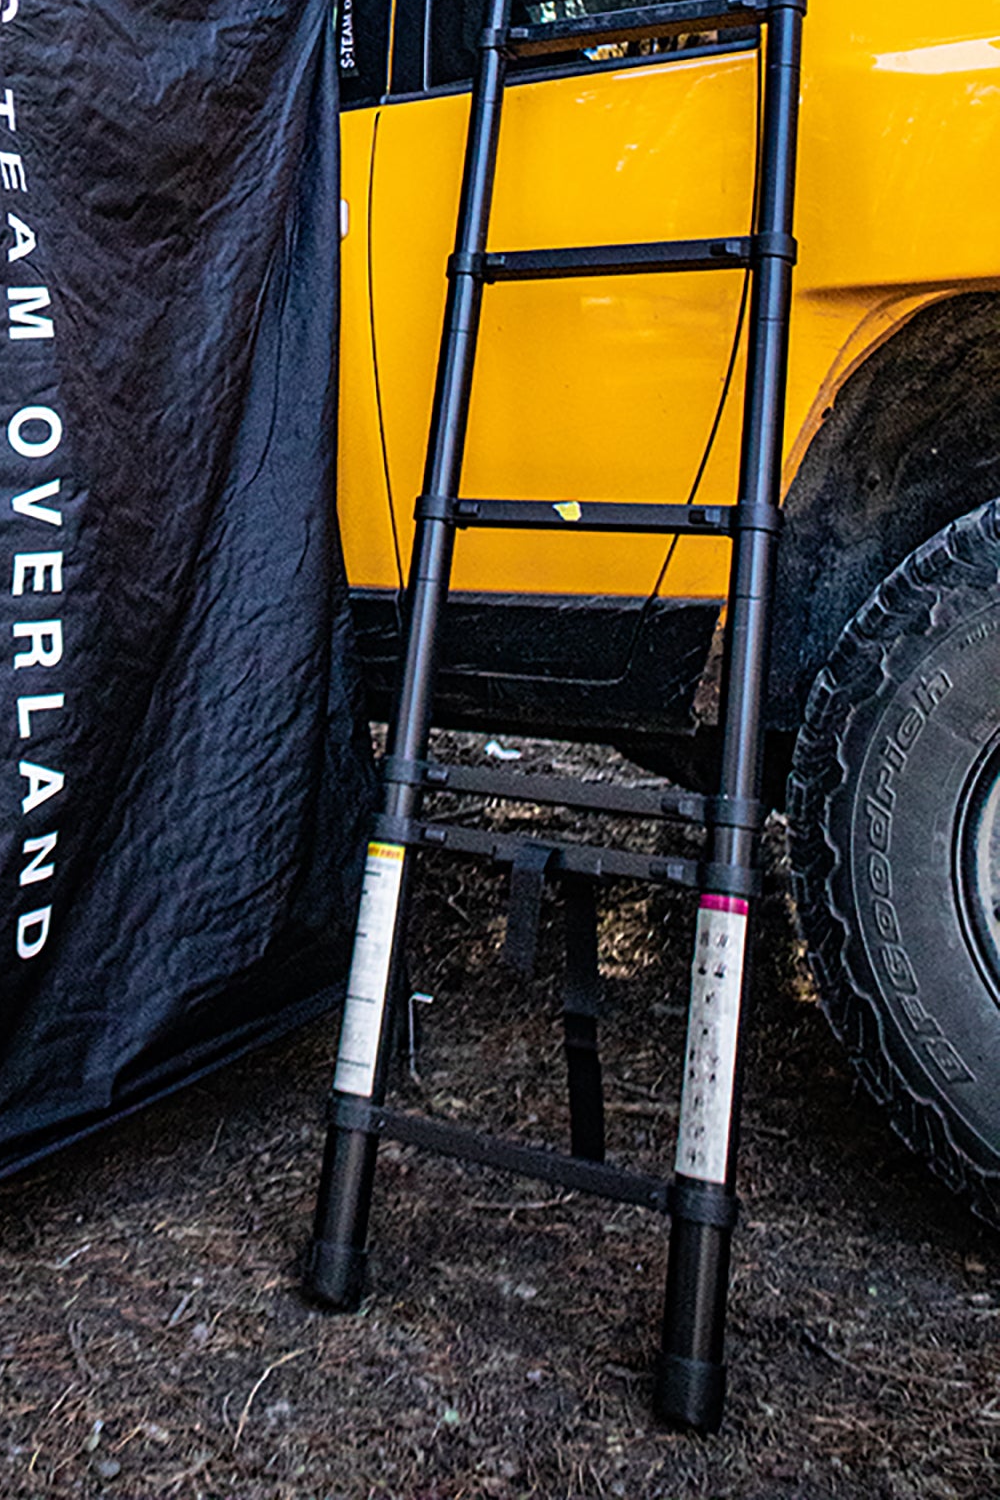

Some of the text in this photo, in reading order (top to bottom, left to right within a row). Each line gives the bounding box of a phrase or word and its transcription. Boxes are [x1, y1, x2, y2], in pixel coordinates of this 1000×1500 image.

[340, 13, 356, 69] S-TEAM
[7, 405, 65, 960] OVERLAND
[866, 667, 979, 1084] BFGoodrich
